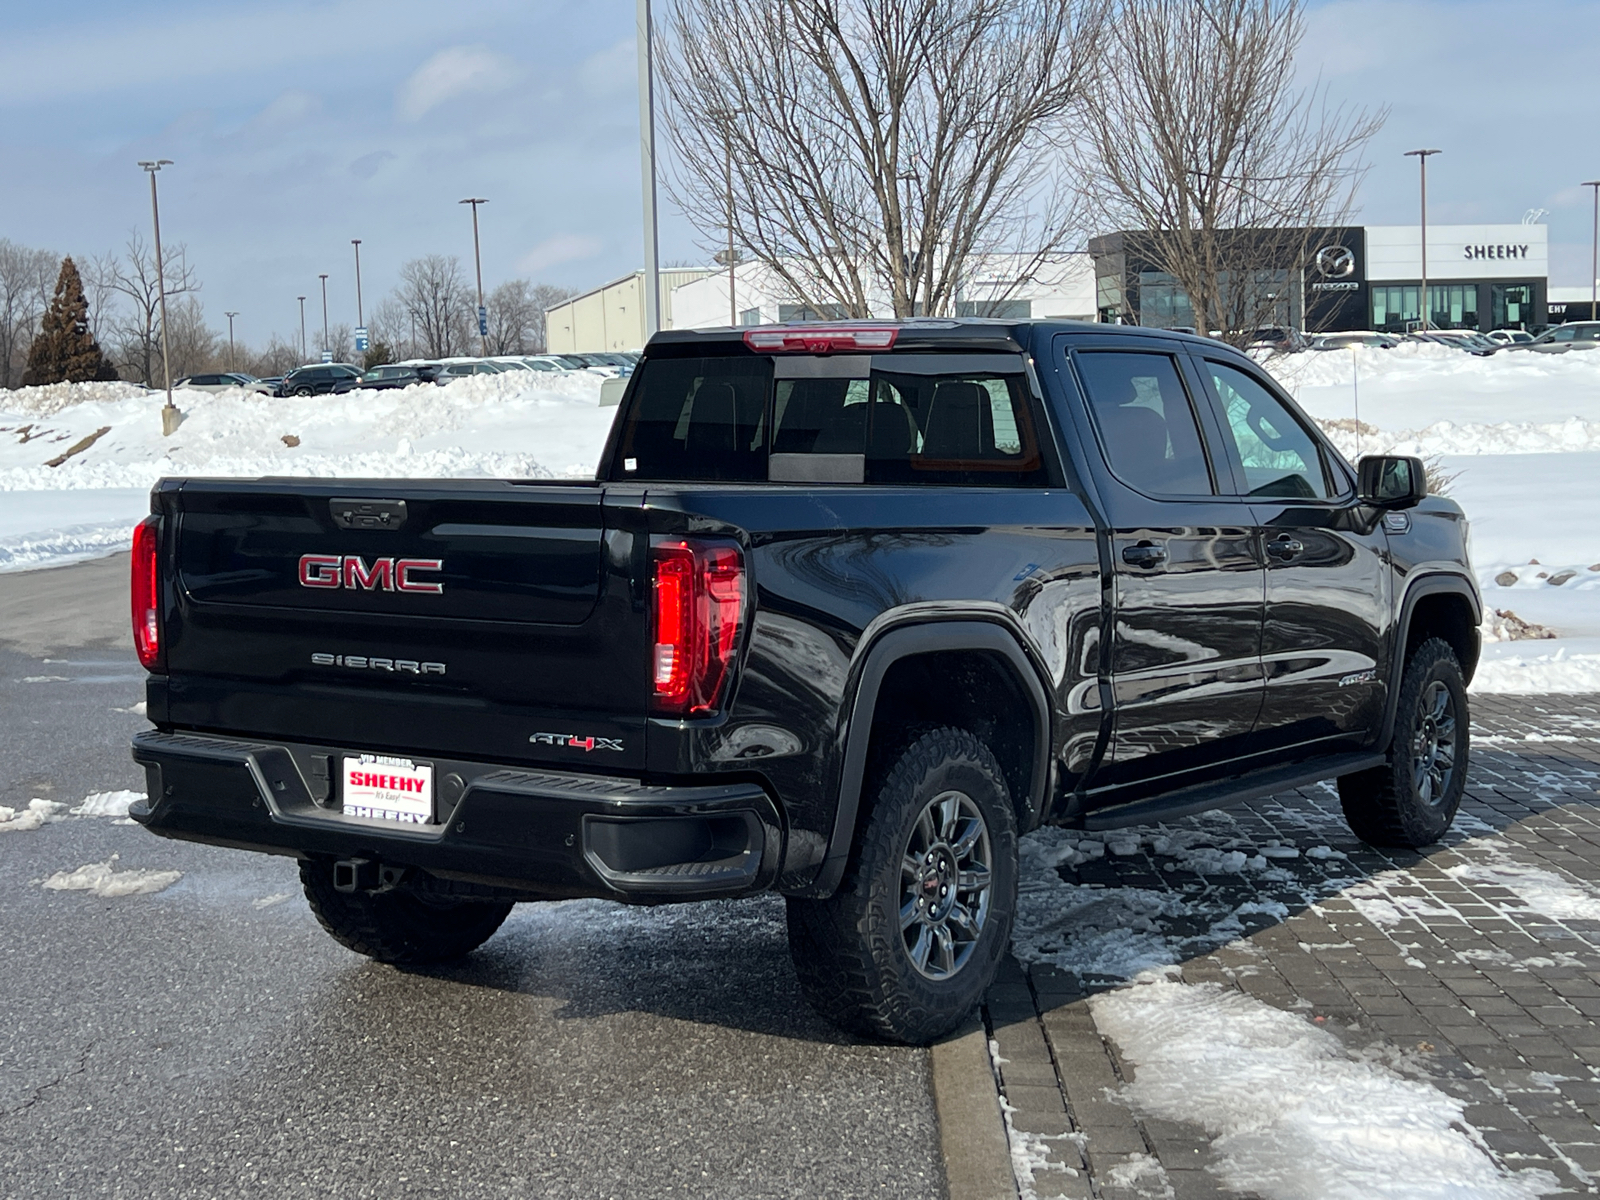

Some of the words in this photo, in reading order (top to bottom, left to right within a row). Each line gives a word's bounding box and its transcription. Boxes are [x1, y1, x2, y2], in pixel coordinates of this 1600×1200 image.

[1464, 244, 1529, 260] SHEEHY
[1548, 304, 1567, 314] EHY
[299, 553, 444, 594] GMC
[311, 652, 446, 675] SIERRA
[529, 732, 624, 752] AT4X
[360, 753, 376, 764] VIP
[376, 756, 413, 769] MEMBER
[349, 771, 425, 793] SHEEHY
[375, 790, 385, 800] It's
[385, 791, 401, 804] Easy!
[343, 805, 430, 825] SHEEHY
